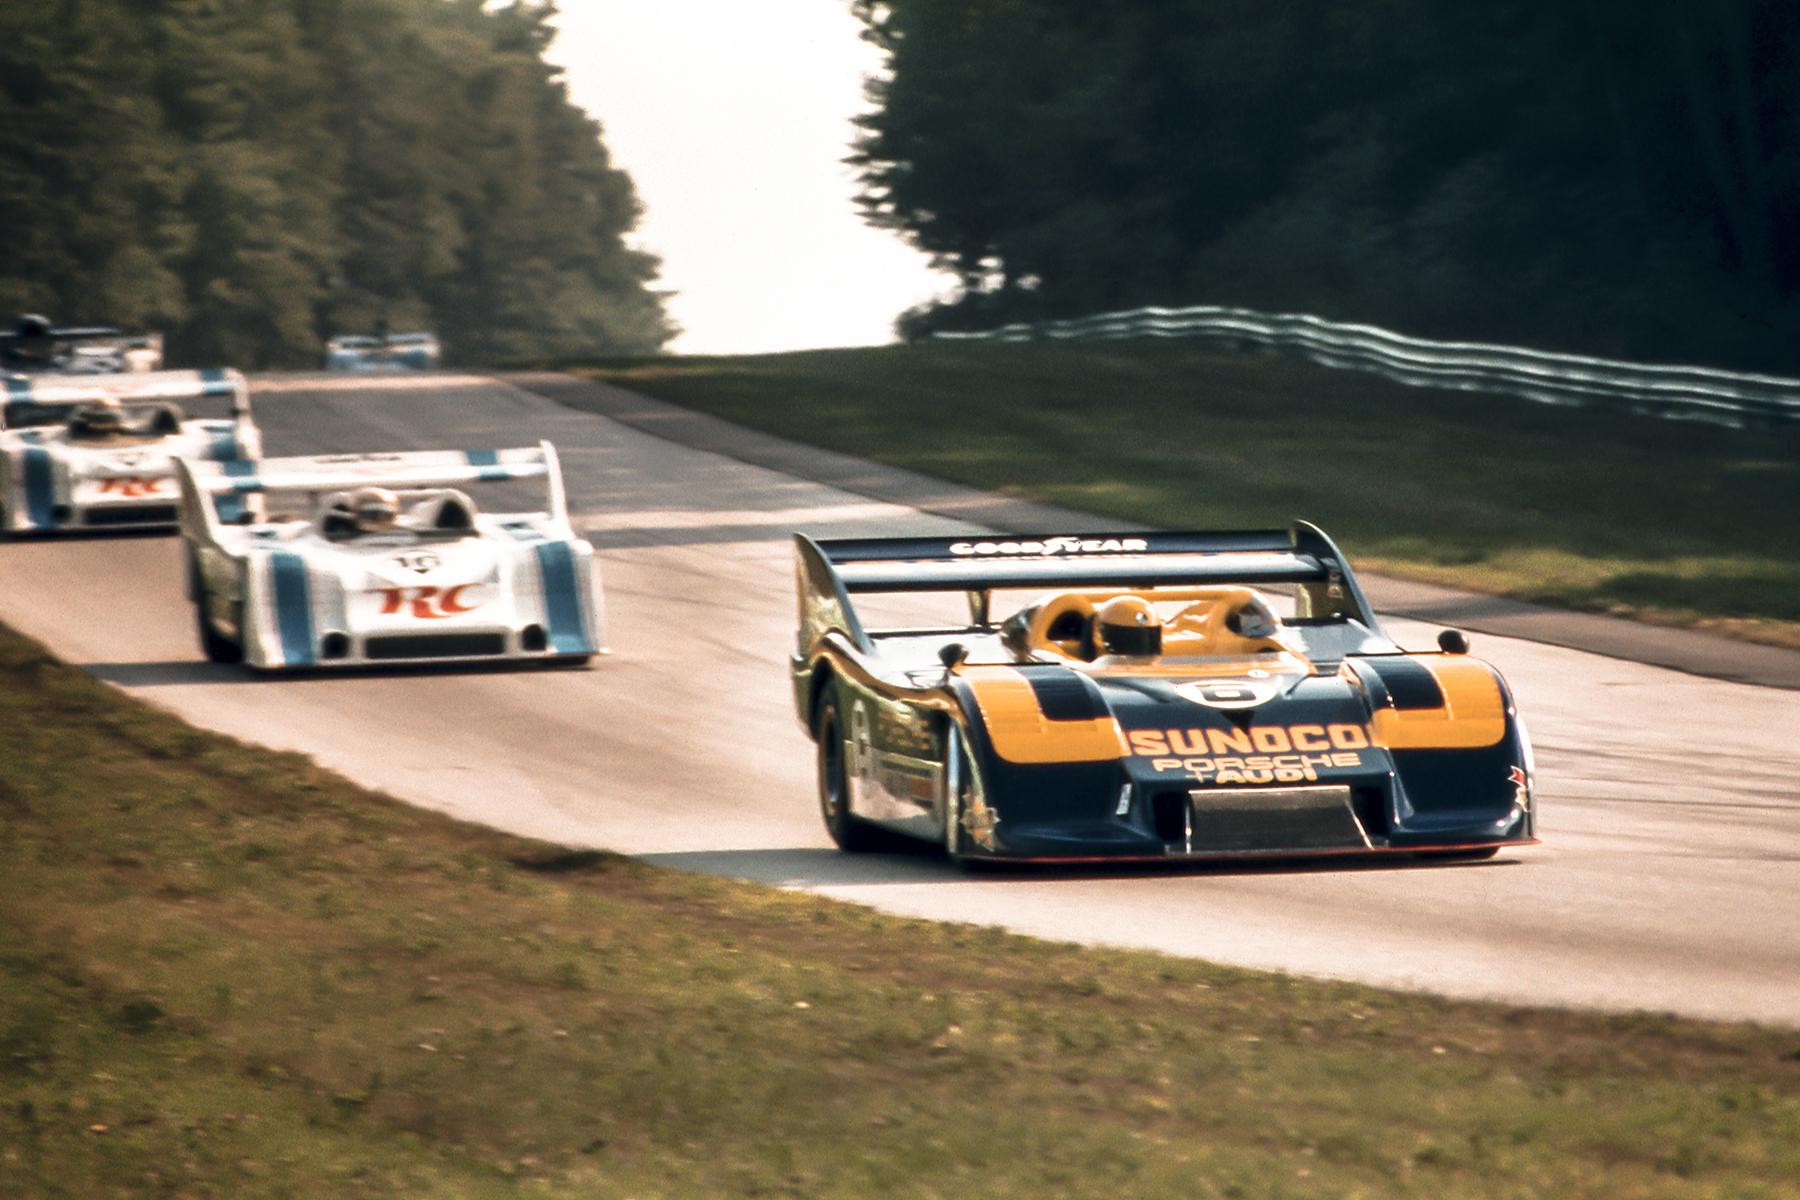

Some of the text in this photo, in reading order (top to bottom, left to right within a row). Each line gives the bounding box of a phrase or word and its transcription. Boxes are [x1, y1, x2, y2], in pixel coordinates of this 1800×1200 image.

[949, 536, 1148, 556] GOODYEAR
[363, 582, 486, 619] RC
[1129, 724, 1369, 756] SUNOCO
[1152, 752, 1361, 772] PORSCHE
